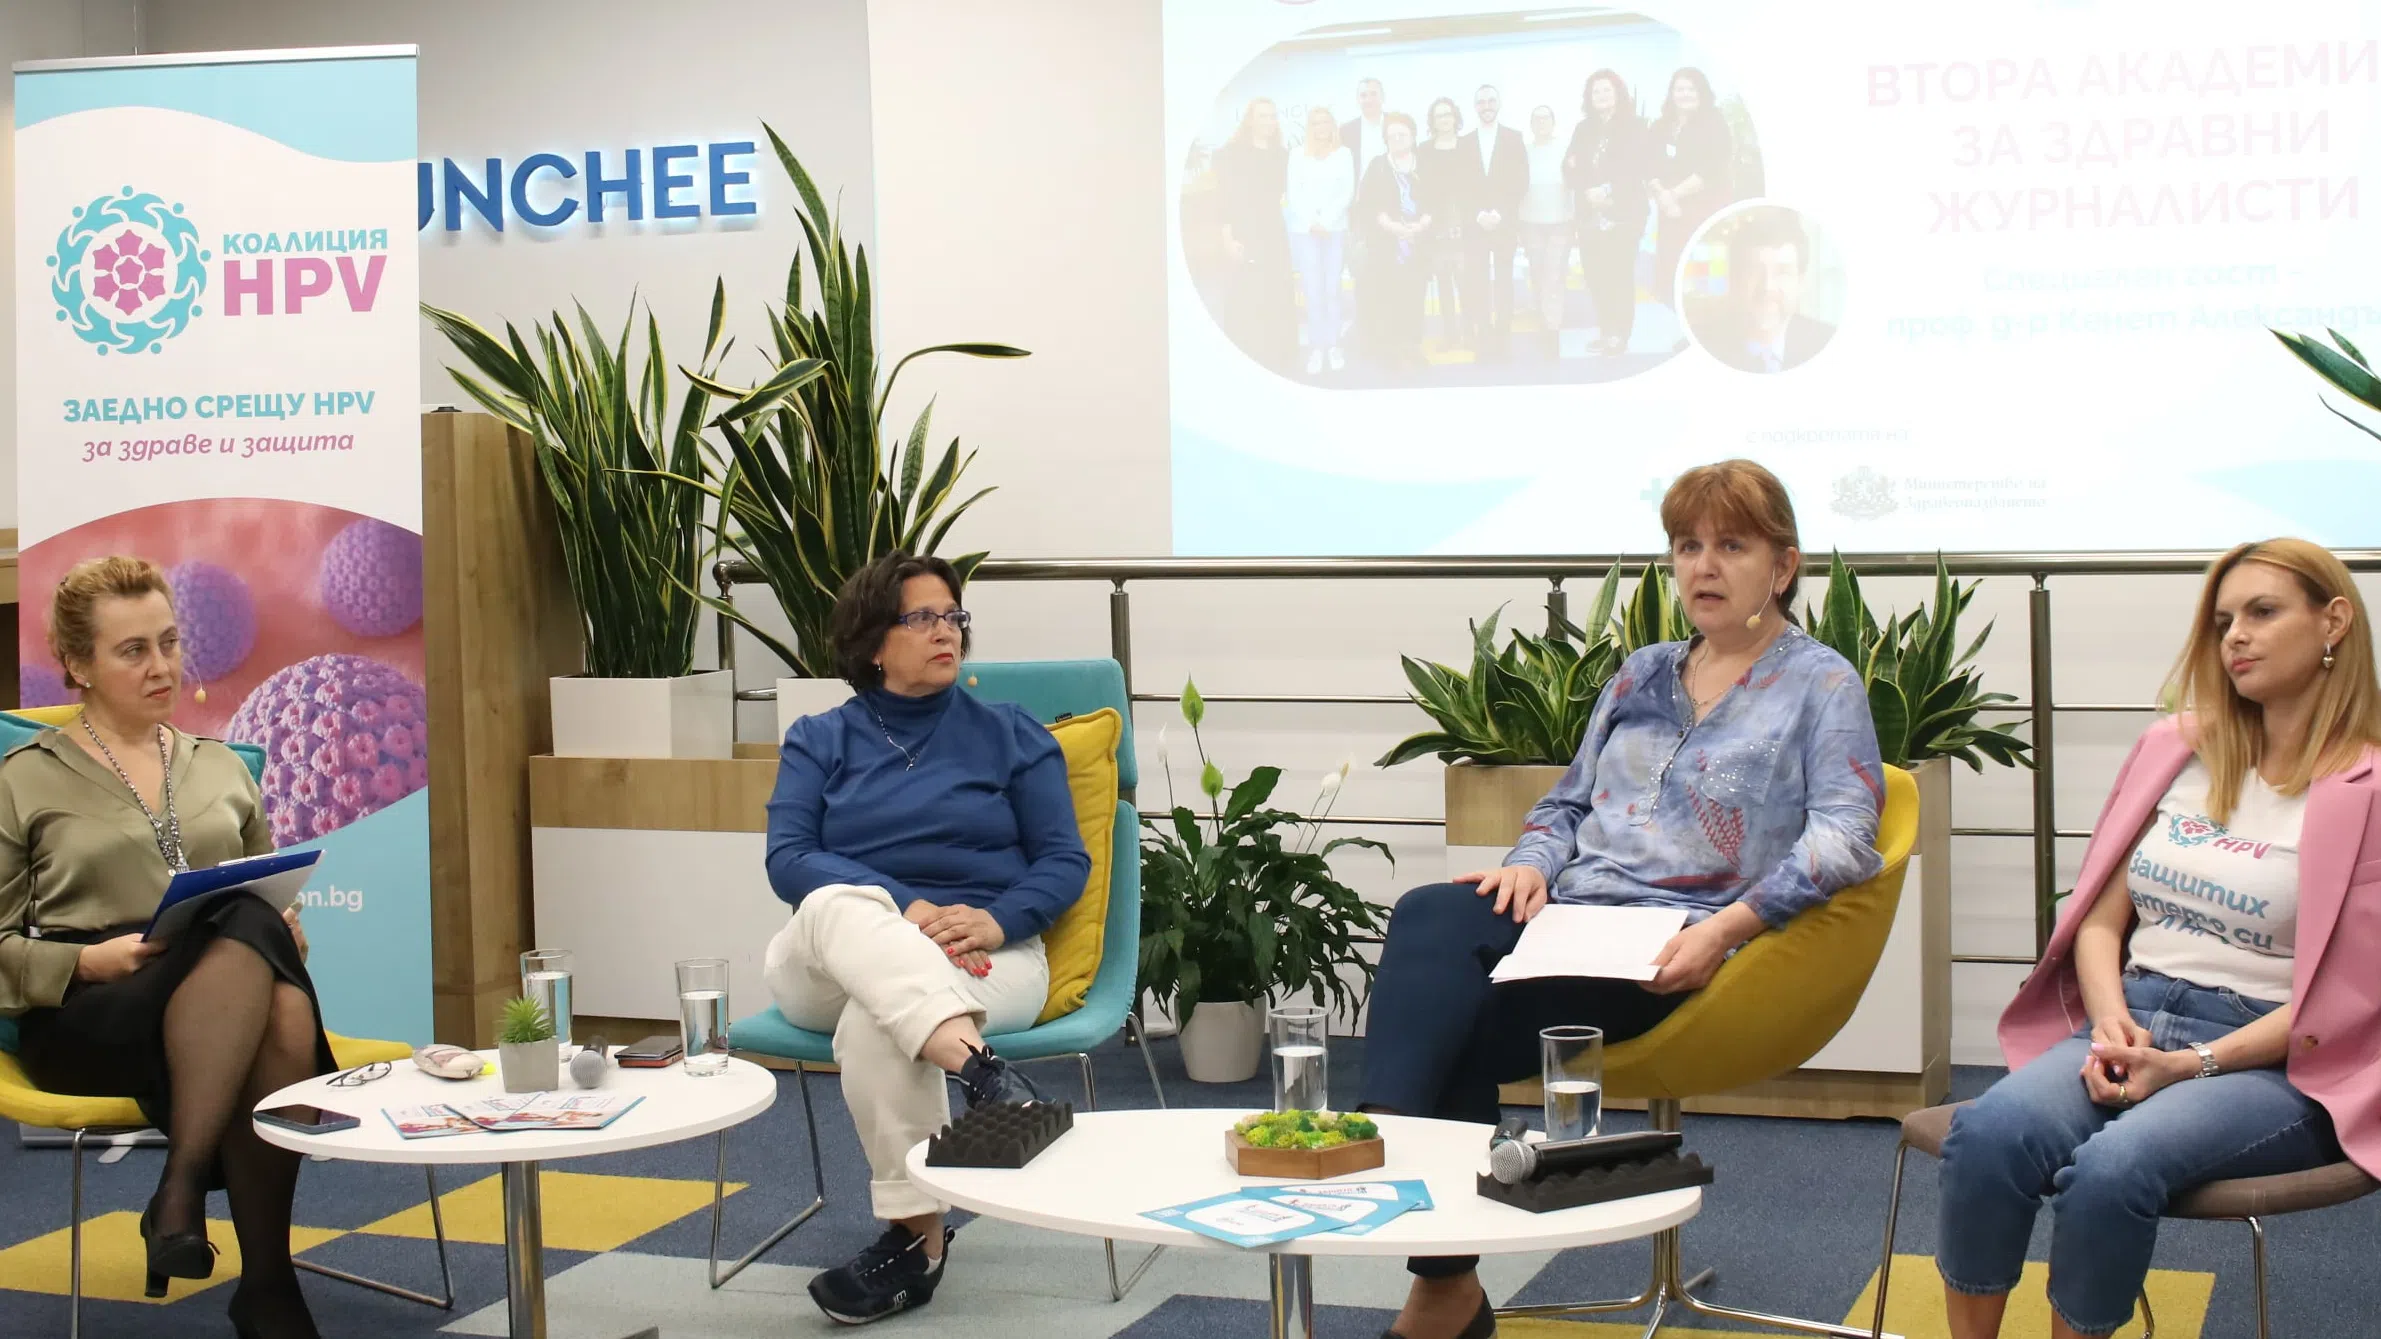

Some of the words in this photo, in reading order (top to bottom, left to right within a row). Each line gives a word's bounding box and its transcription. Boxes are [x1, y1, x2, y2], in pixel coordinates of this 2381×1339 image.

[1867, 57, 2058, 106] ВТОРА
[2077, 39, 2378, 99] АКАДЕМИ
[1952, 123, 2024, 167] ЗА
[2039, 109, 2330, 170] ЗДРАВНИ
[1927, 176, 2359, 234] ЖУРНАЛИСТИ
[223, 228, 388, 254] КОАЛИЦИЯ
[224, 255, 387, 316] HPV
[63, 396, 188, 425] ЗАЕДНО
[195, 393, 306, 420] СРЕЩУ
[314, 390, 375, 415] HPV
[82, 440, 112, 463] за
[118, 433, 212, 462] здраве
[219, 436, 235, 453] и
[241, 433, 354, 458] защита
[2213, 837, 2271, 859] HPV
[2129, 850, 2270, 919] Защитих
[2131, 889, 2227, 933] етето
[2233, 927, 2273, 950] си
